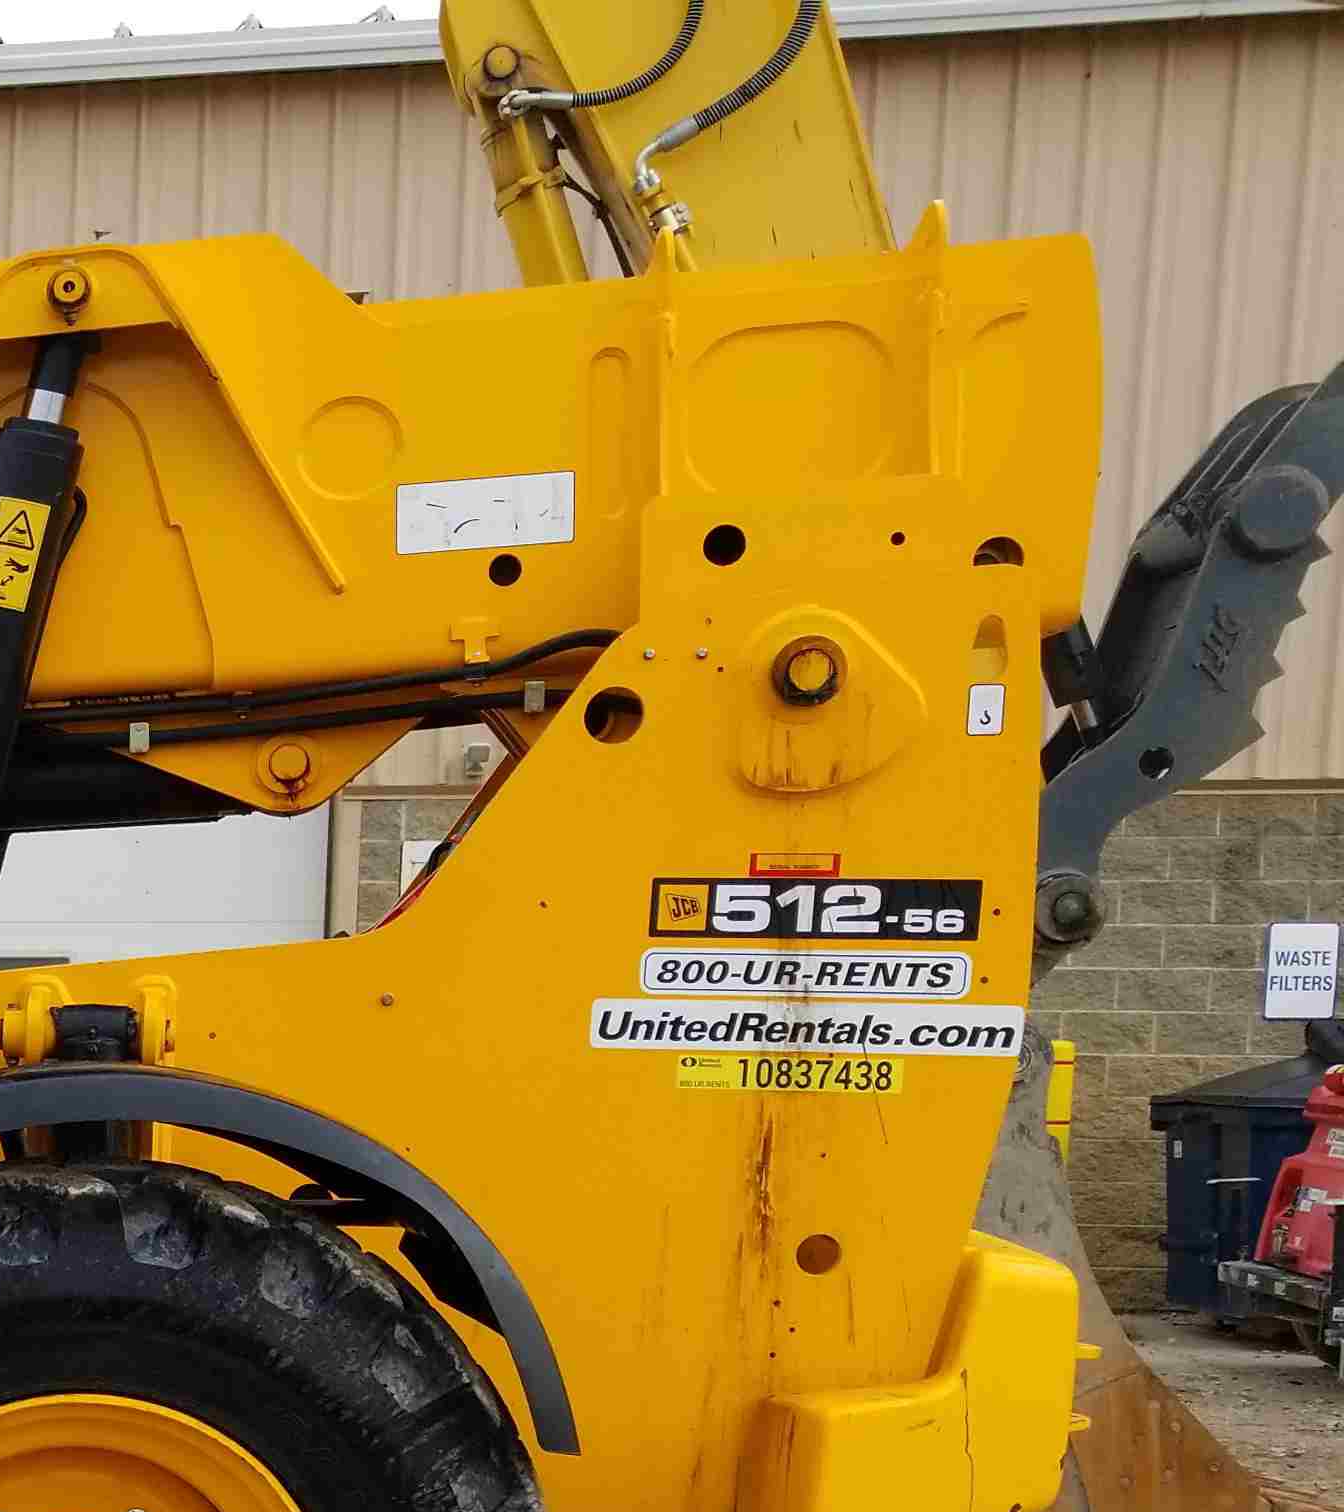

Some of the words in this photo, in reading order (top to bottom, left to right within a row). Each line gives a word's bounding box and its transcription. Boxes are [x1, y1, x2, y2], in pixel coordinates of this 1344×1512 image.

[670, 895, 701, 919] JCB
[712, 884, 965, 934] 512-56
[656, 958, 955, 989] 800-UR-RENTS
[1274, 950, 1332, 967] WASTE
[1269, 975, 1333, 992] FILTERS
[598, 1010, 1016, 1049] UnitedRentals.com
[737, 1058, 893, 1091] 10837438
